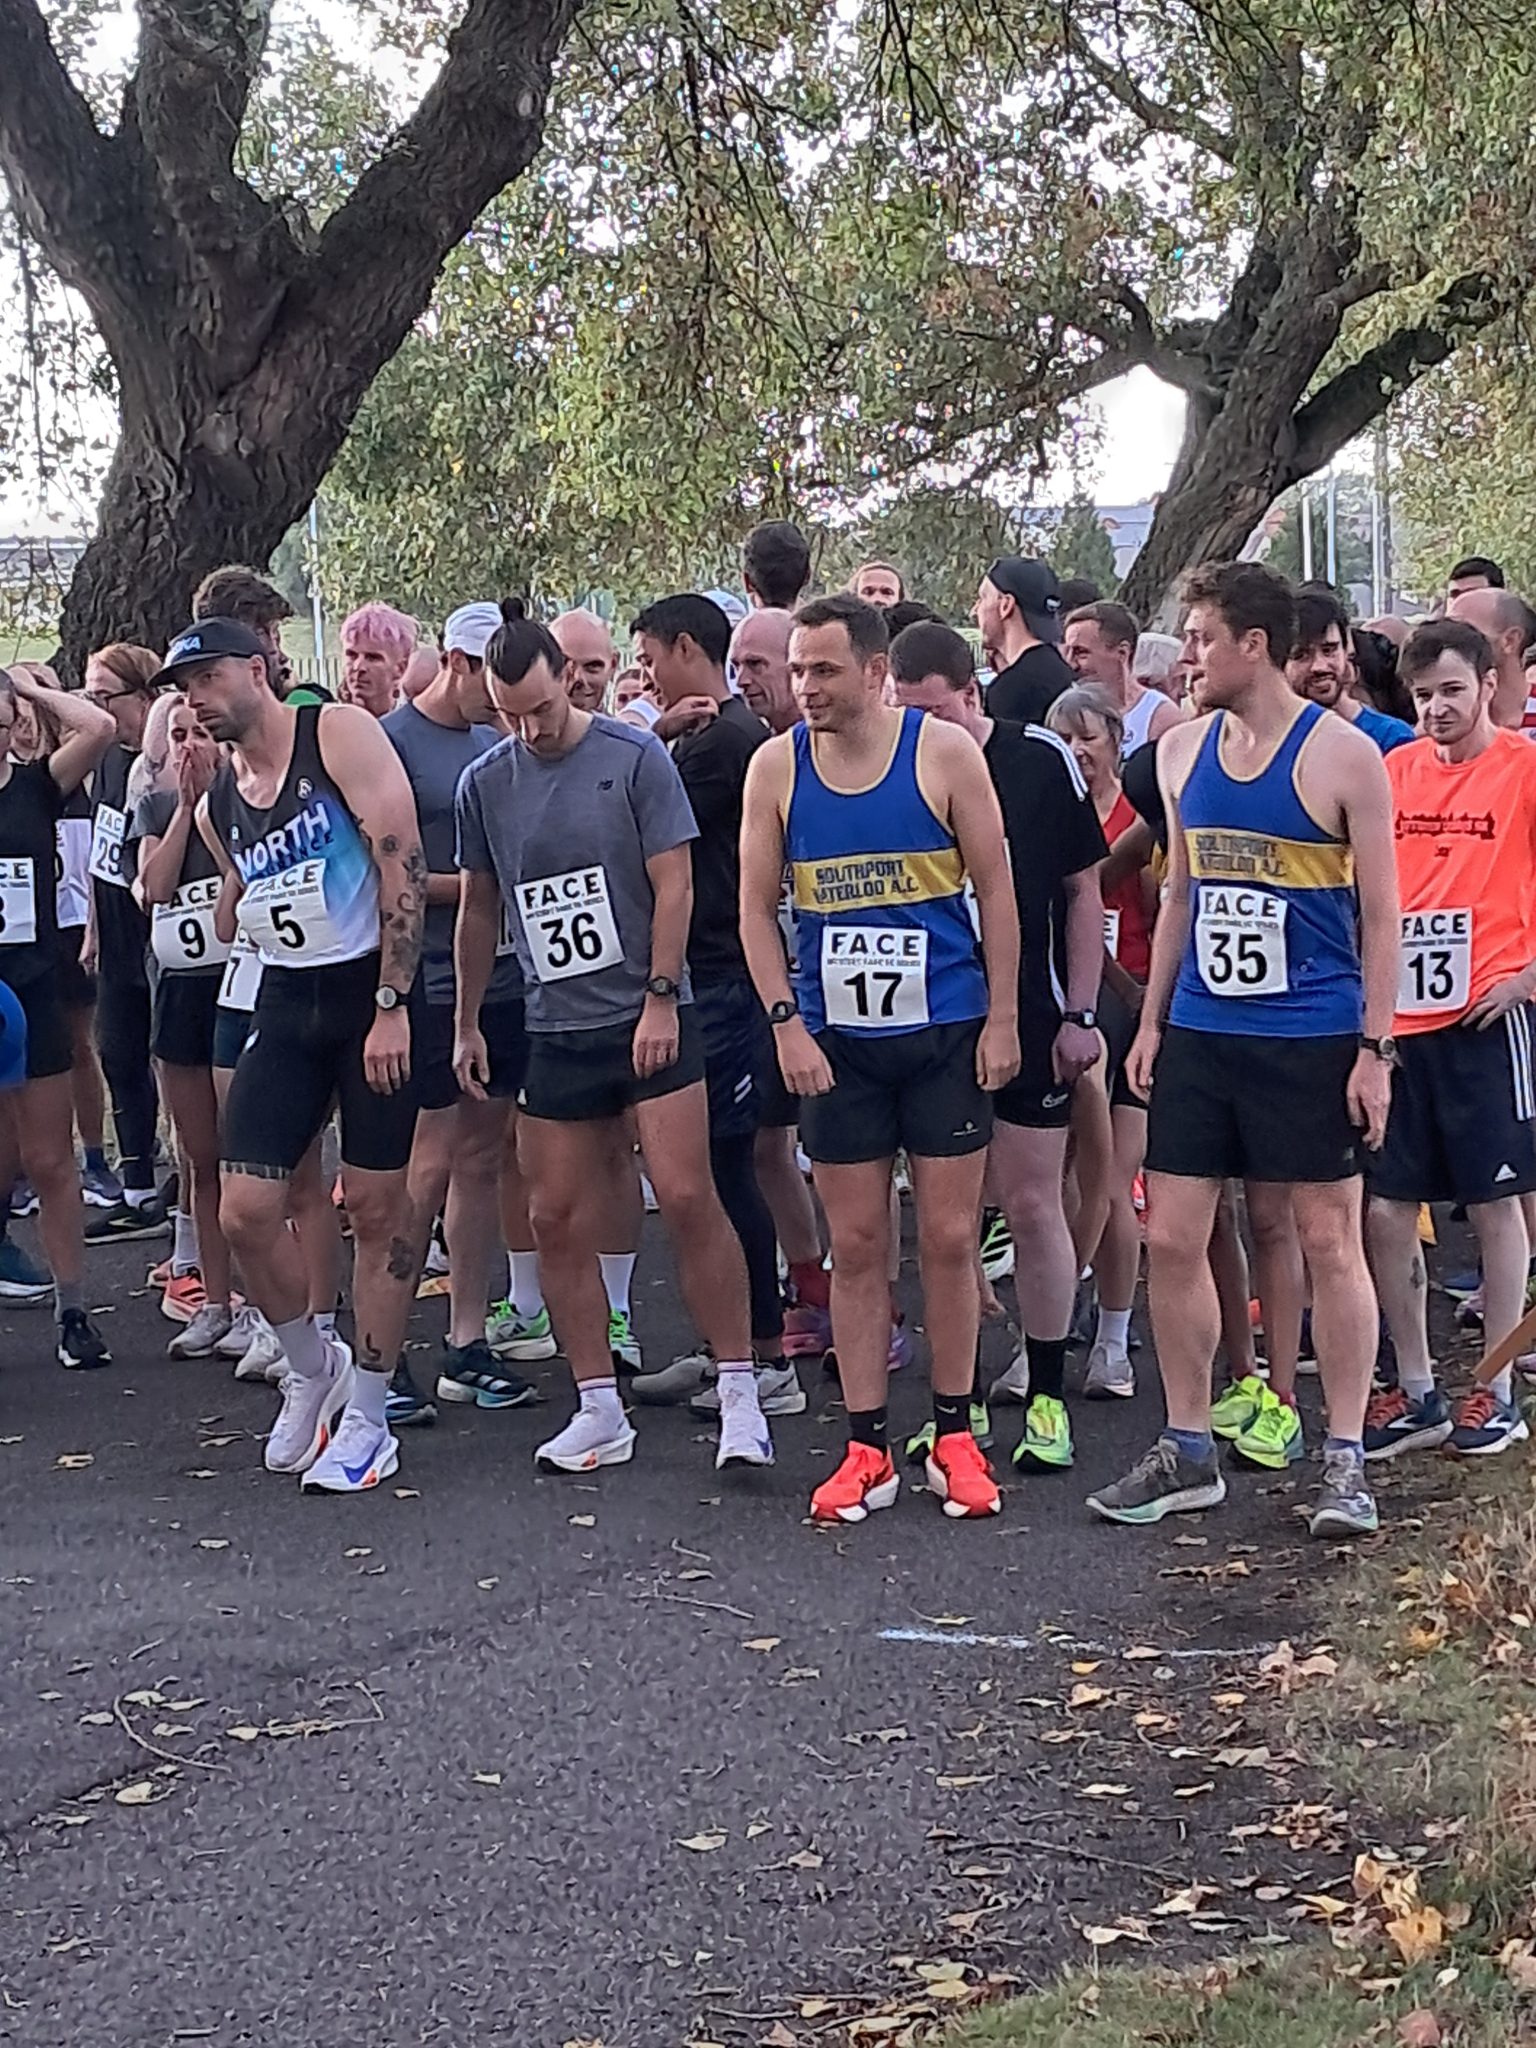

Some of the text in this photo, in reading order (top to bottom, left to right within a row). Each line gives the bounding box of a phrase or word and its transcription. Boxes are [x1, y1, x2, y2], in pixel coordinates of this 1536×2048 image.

[234, 802, 331, 884] NORTH
[815, 860, 904, 885] SOUTHPORT
[178, 918, 206, 959] 9
[270, 903, 306, 949] 5
[540, 912, 603, 968] 36
[1208, 930, 1268, 984] 35
[1407, 951, 1454, 1001] 13
[843, 971, 903, 1018] 17
